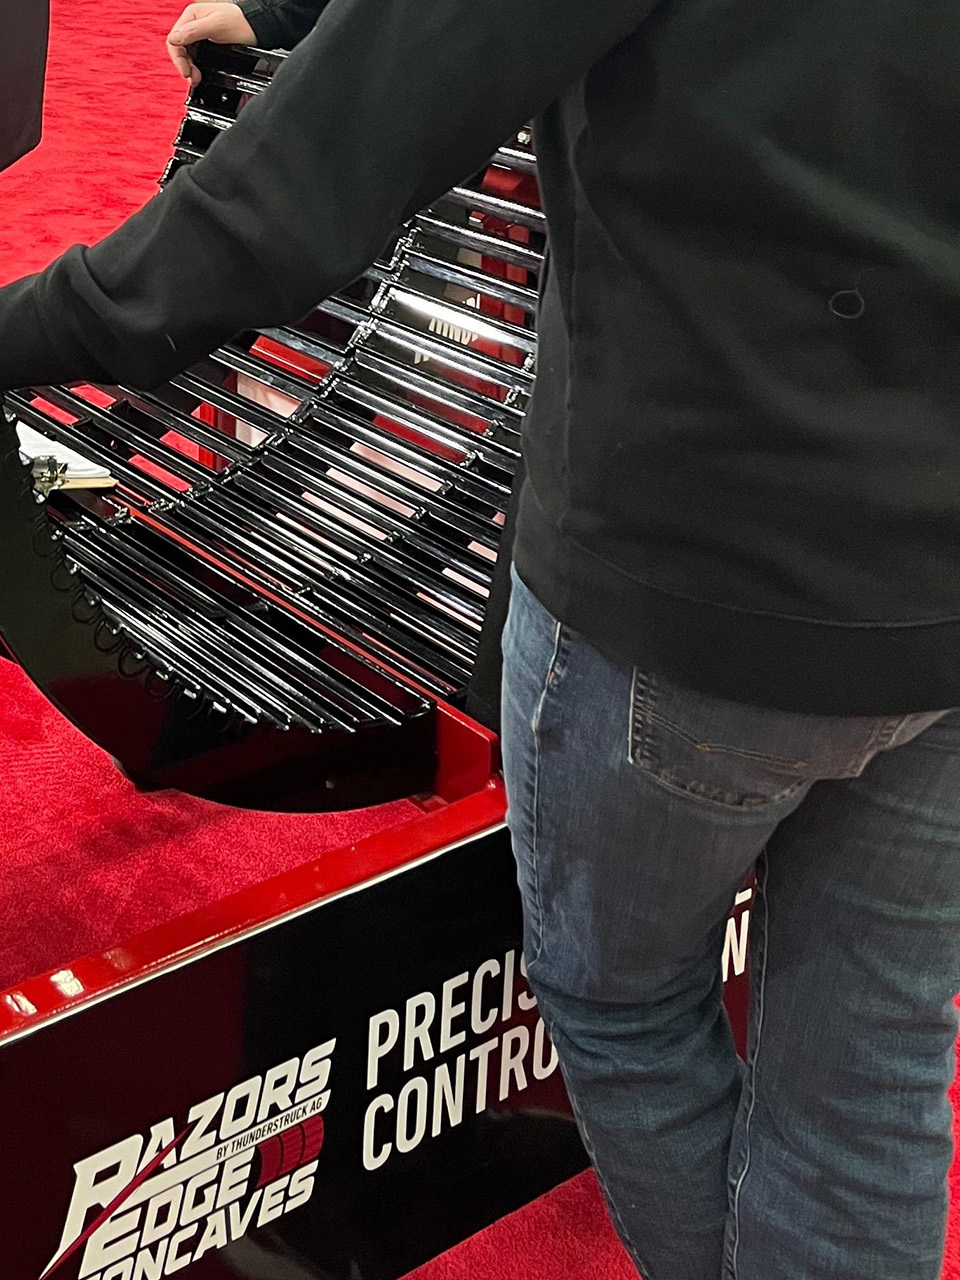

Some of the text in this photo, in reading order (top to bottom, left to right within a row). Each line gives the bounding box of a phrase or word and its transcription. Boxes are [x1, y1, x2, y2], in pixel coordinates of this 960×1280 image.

[39, 1037, 337, 1280] RAZORS
[216, 1097, 323, 1161] BY THUNDERSTRUCK AG
[78, 1146, 256, 1280] EDGE
[82, 1159, 319, 1280] ONCAVES
